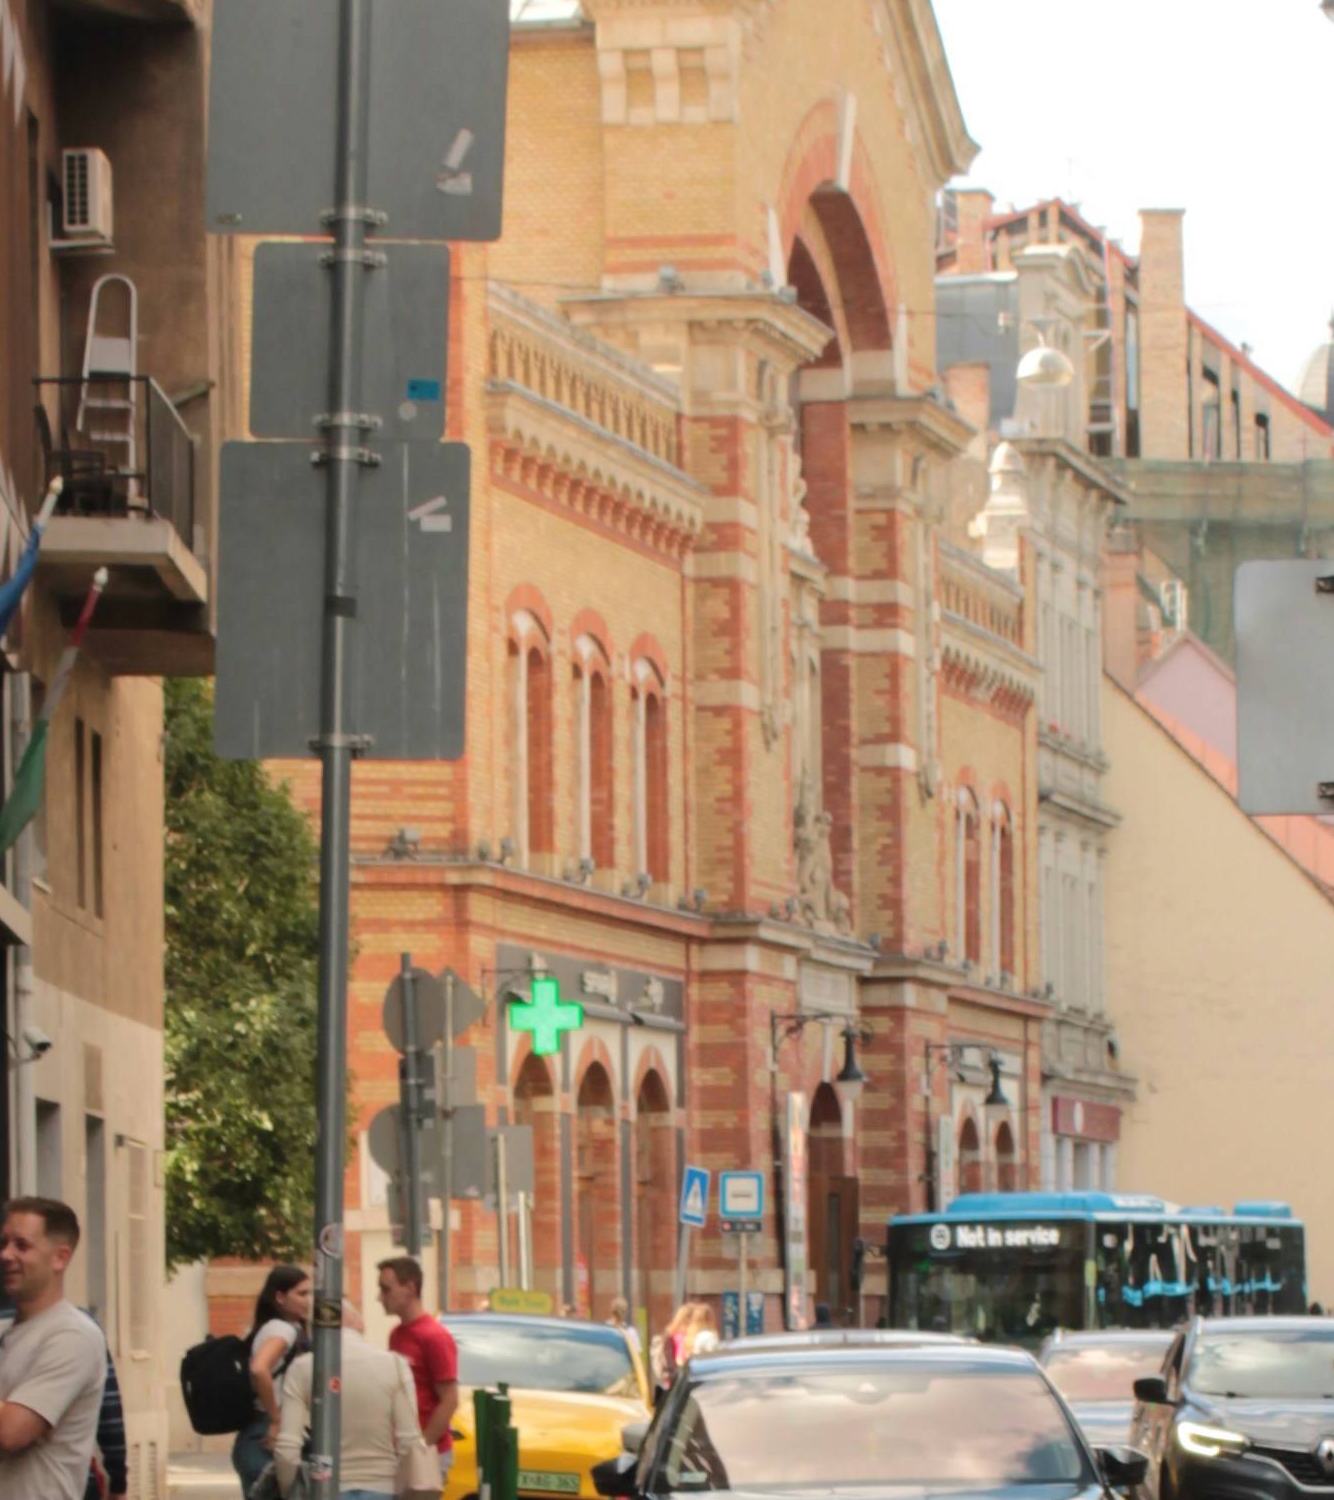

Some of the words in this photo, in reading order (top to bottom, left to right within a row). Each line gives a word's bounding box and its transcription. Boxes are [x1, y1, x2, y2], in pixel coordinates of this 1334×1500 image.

[956, 1224, 986, 1248] Not
[987, 1226, 1003, 1247] in
[1004, 1225, 1060, 1246] service
